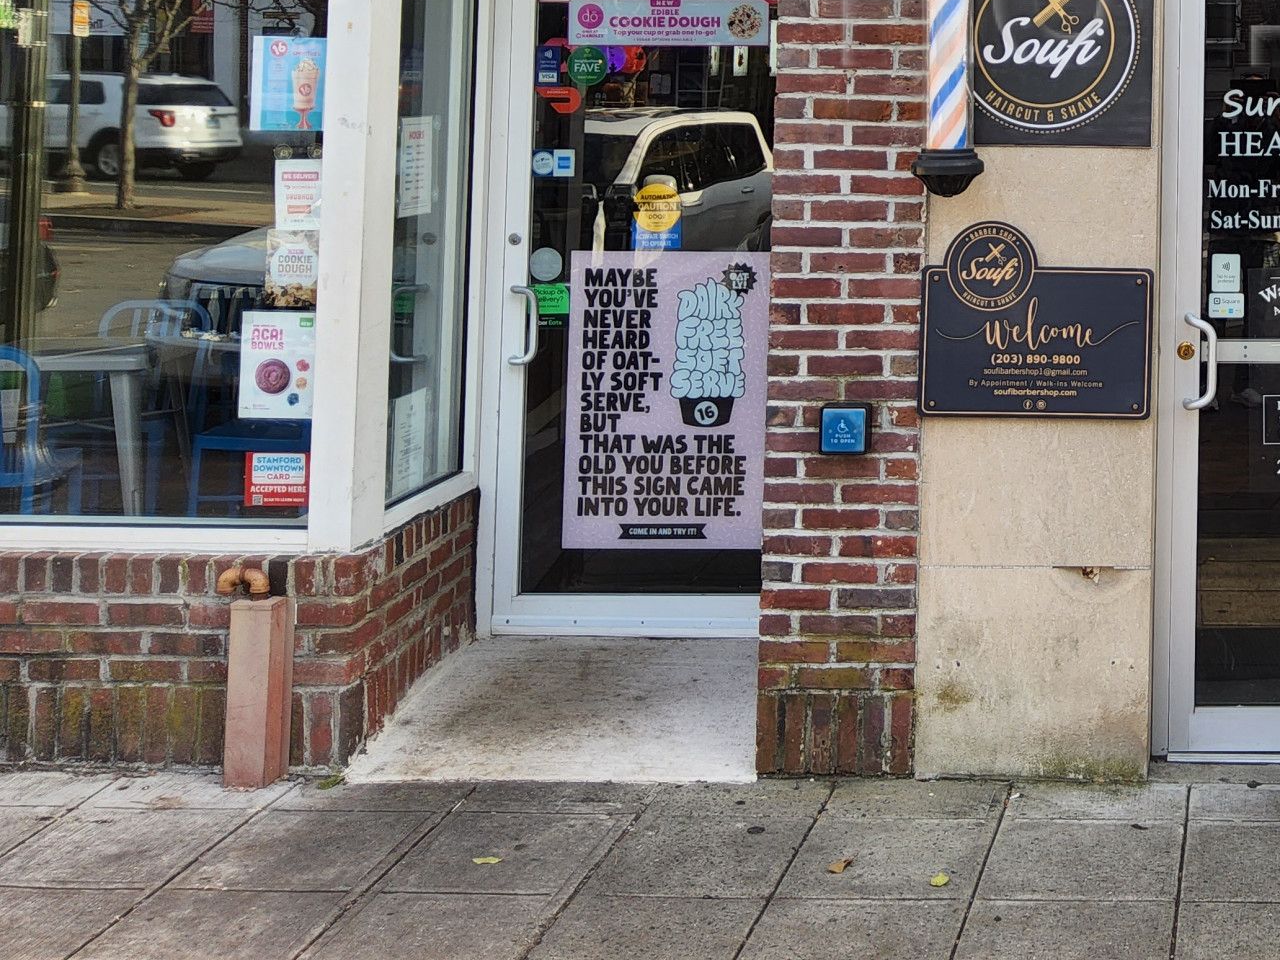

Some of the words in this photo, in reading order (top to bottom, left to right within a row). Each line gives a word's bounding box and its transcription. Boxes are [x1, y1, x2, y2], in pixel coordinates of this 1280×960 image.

[609, 17, 665, 27] COOKIE
[668, 17, 721, 27] DOUGH
[983, 16, 1105, 79] Soufi
[574, 64, 601, 72] FAVE
[985, 90, 1041, 122] HAIRCUT
[1047, 110, 1054, 121] &
[1061, 91, 1101, 119] SHAVE
[970, 227, 996, 240] BARBER
[999, 229, 1016, 242] SHOP
[278, 255, 313, 263] COOKIE
[278, 264, 312, 273] DOUGH
[584, 268, 658, 287] MAYBE
[962, 258, 1018, 286] Soufi
[584, 289, 659, 309] YOU'VE
[676, 277, 745, 321] DAIRY
[962, 291, 988, 307] HAIRCUT
[997, 292, 1016, 306] SHAVE
[583, 310, 651, 329] NEVER
[975, 297, 1108, 351] Welcome
[252, 328, 283, 340] ACAI
[583, 330, 650, 350] HEARD
[676, 317, 744, 350] FREE
[251, 341, 284, 350] BOWLS
[582, 351, 605, 370] OF
[612, 351, 661, 370] OAT-
[673, 346, 744, 376] SOFT
[991, 354, 1023, 364] (203)
[1026, 354, 1081, 364] 890-9800
[581, 372, 604, 391] LY
[610, 372, 663, 391] SOFT
[983, 367, 1088, 377] soufibarbershop1@gmail.com
[669, 370, 746, 399] SERVE
[969, 379, 978, 388] By
[981, 379, 1028, 388] Appointment
[1070, 380, 1103, 388] Welcome
[994, 388, 1077, 397] soufibarbershop.com
[580, 392, 650, 413] SERVE,
[697, 403, 715, 422] 16
[580, 413, 621, 433] BUT
[579, 435, 635, 454] THAT
[641, 435, 688, 454] WAS
[693, 435, 735, 454] THE
[578, 456, 616, 475] OLD
[623, 456, 664, 475] YOU
[669, 456, 747, 475] BEFORE
[578, 476, 627, 495] THIS
[633, 476, 681, 495] SIGN
[687, 476, 745, 495] CAME
[577, 497, 628, 517] INTO
[634, 497, 688, 517] YOUR
[694, 497, 741, 517] LIFE.
[629, 527, 648, 536] COME
[650, 527, 657, 536] IN
[658, 527, 671, 536] AND
[673, 527, 686, 536] TRY
[687, 527, 697, 536] IT!
